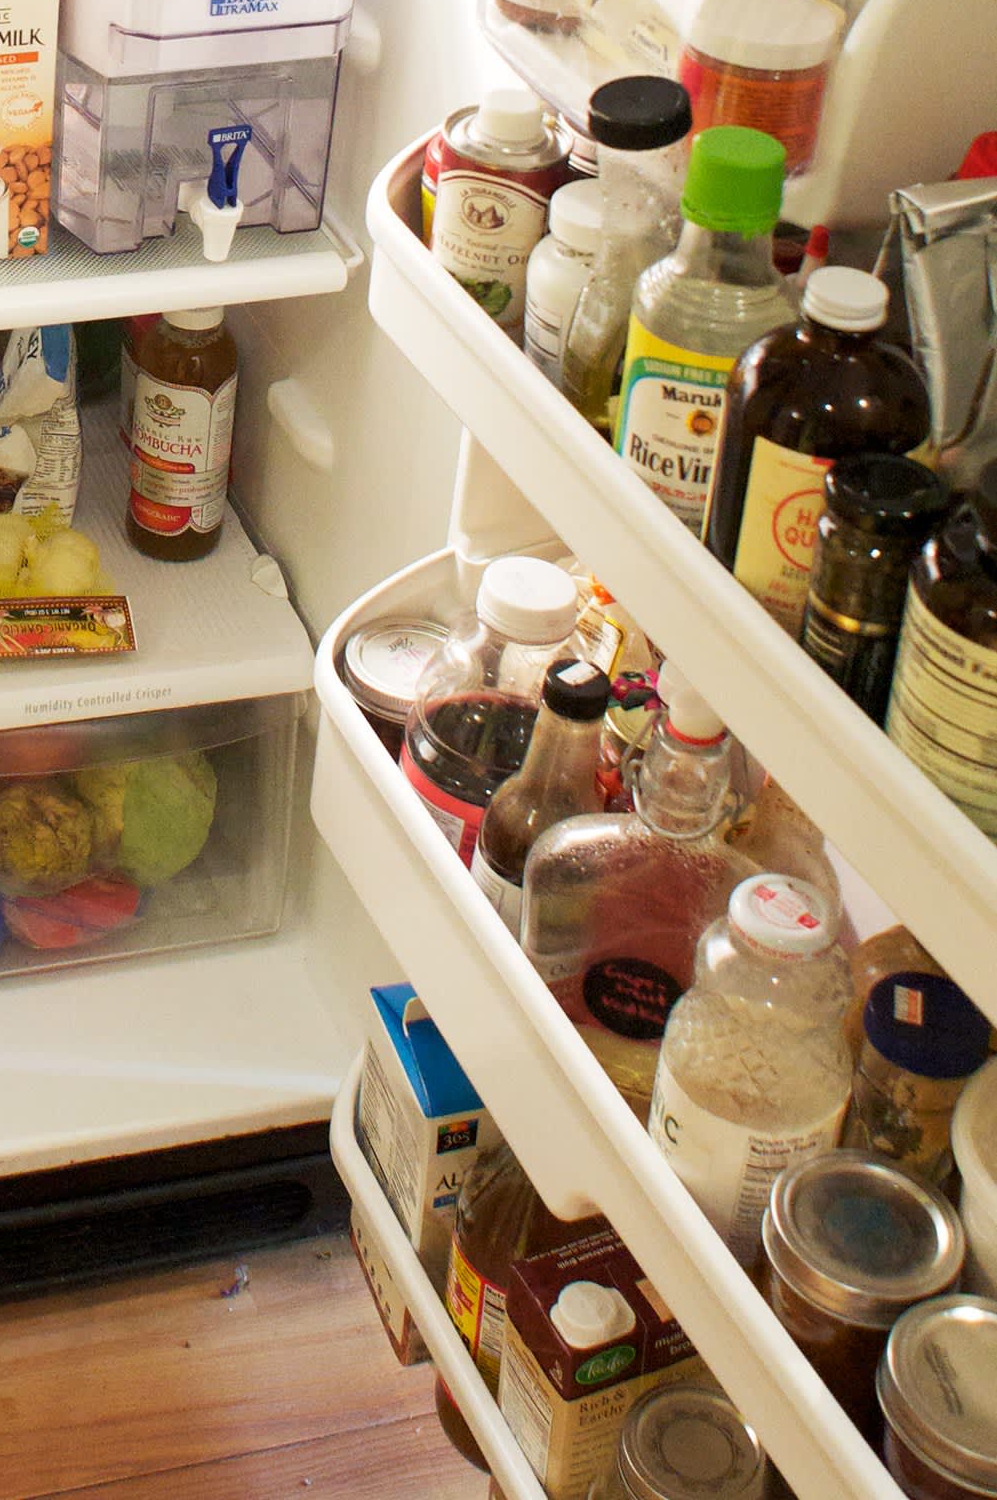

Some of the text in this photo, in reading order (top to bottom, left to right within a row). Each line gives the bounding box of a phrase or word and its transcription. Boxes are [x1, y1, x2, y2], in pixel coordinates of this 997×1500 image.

[221, 131, 247, 143] BRITA
[507, 254, 526, 265] OI
[661, 384, 723, 408] Maruk
[629, 432, 674, 477] Rice
[784, 526, 816, 549] QU
[3, 621, 96, 636] ORGANIC GARLIC
[25, 687, 173, 715] Humidity Controlled Crisper
[443, 1131, 471, 1149] 365
[435, 1172, 462, 1192] AL
[670, 1340, 692, 1355] bro
[578, 1395, 611, 1414] Rich
[578, 1404, 625, 1427] Earthy
